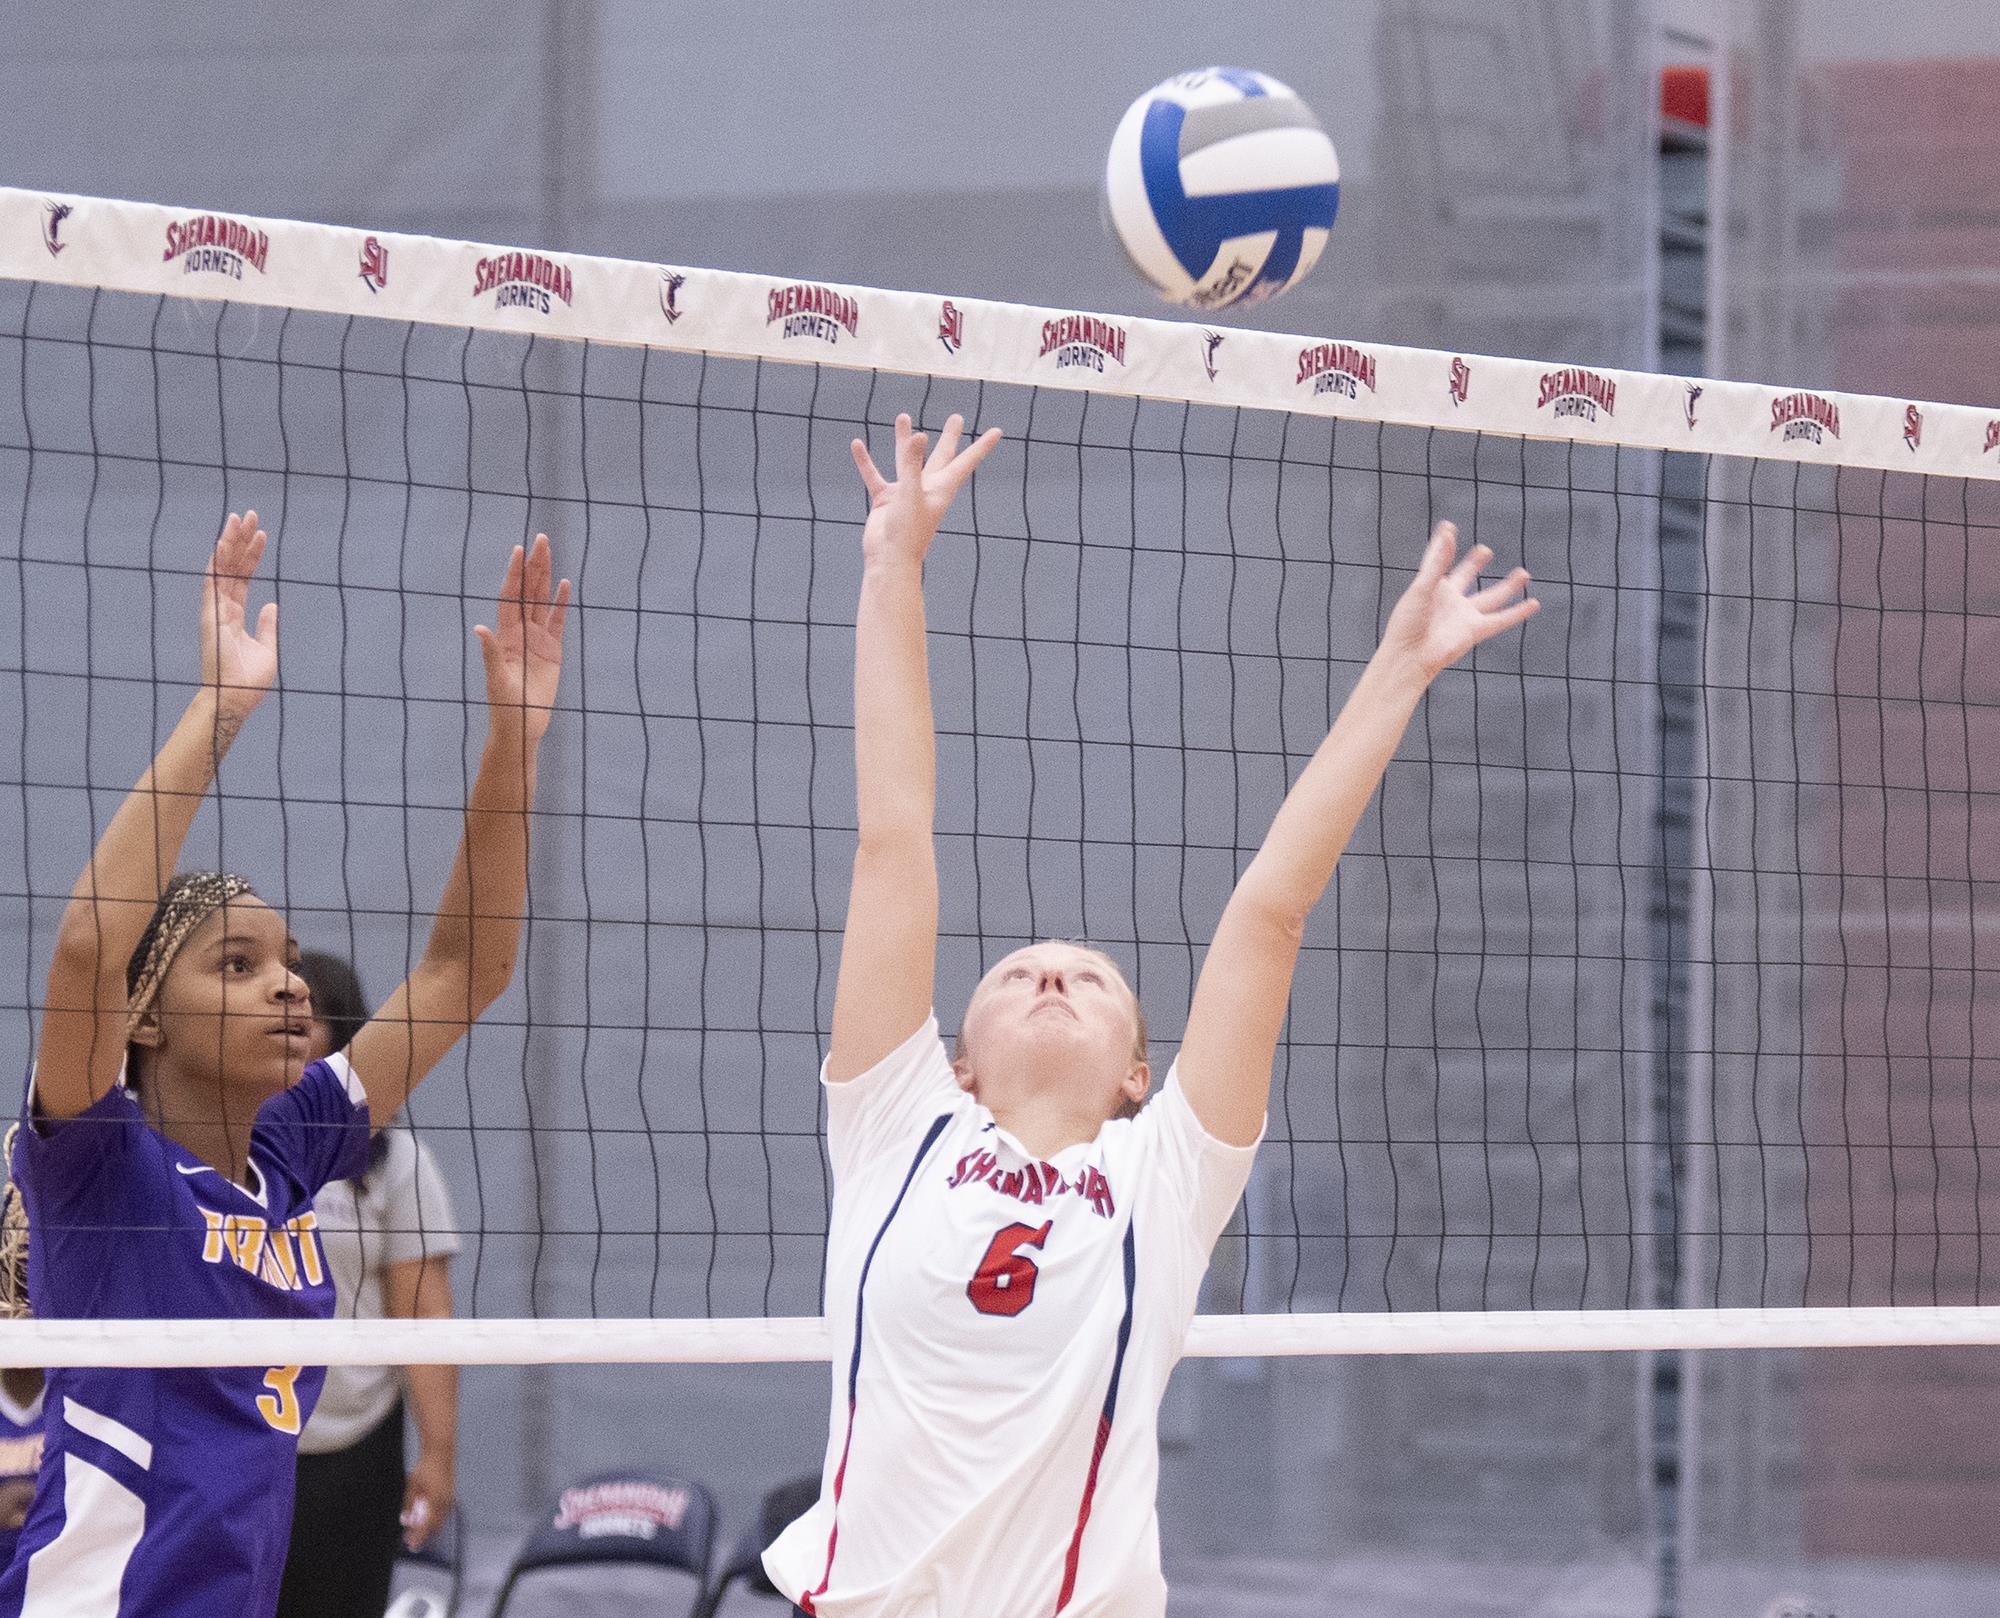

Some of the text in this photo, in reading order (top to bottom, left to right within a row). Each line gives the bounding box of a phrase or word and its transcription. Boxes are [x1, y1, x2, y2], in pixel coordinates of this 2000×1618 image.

[163, 215, 268, 274] SHENANDOAH
[184, 249, 242, 280] HORNETS
[473, 252, 573, 307] SHENANDOAH
[495, 285, 550, 314] HORNETS
[766, 284, 858, 338] SHENANDOAH
[783, 314, 838, 344] HORNETS
[1039, 315, 1126, 367] SHENANDOAH
[1056, 346, 1105, 373] HORNETS
[1296, 343, 1376, 393] SHENANDOAH
[1537, 368, 1616, 417] SHENANDOAH
[966, 1219, 1054, 1318] 6
